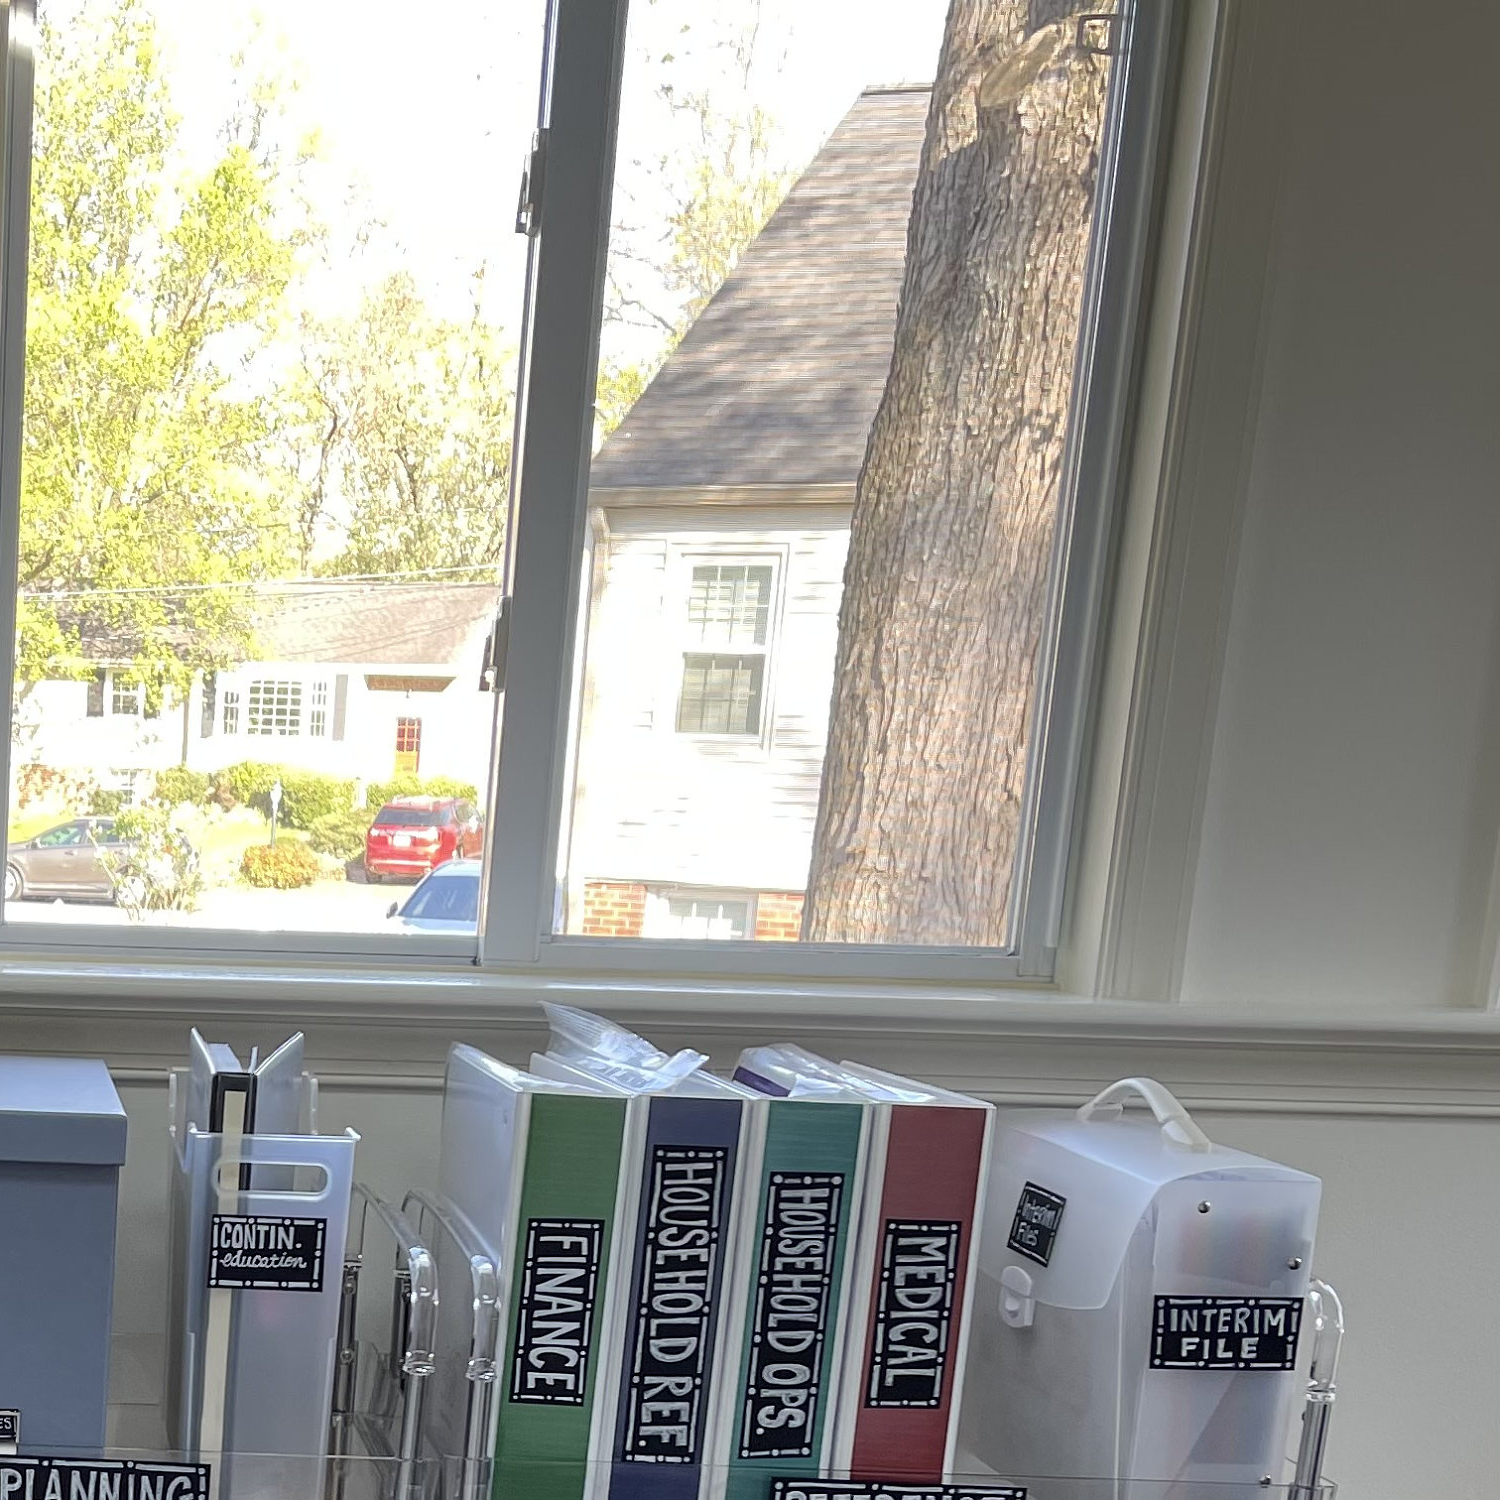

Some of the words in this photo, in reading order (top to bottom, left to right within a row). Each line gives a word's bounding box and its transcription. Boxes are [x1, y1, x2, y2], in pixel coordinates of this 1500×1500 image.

[219, 1250, 307, 1269] education
[220, 1223, 302, 1250] CONTIN.
[648, 1162, 715, 1363] HOUSEHOLD
[765, 1187, 831, 1353] HOUSEHOLD
[525, 1235, 588, 1391] FINANCE
[884, 1236, 948, 1388] MEDICAL
[1170, 1308, 1286, 1336] INTERIM
[1181, 1337, 1260, 1360] FILE
[638, 1375, 694, 1448] REF.
[755, 1363, 810, 1436] OPS.
